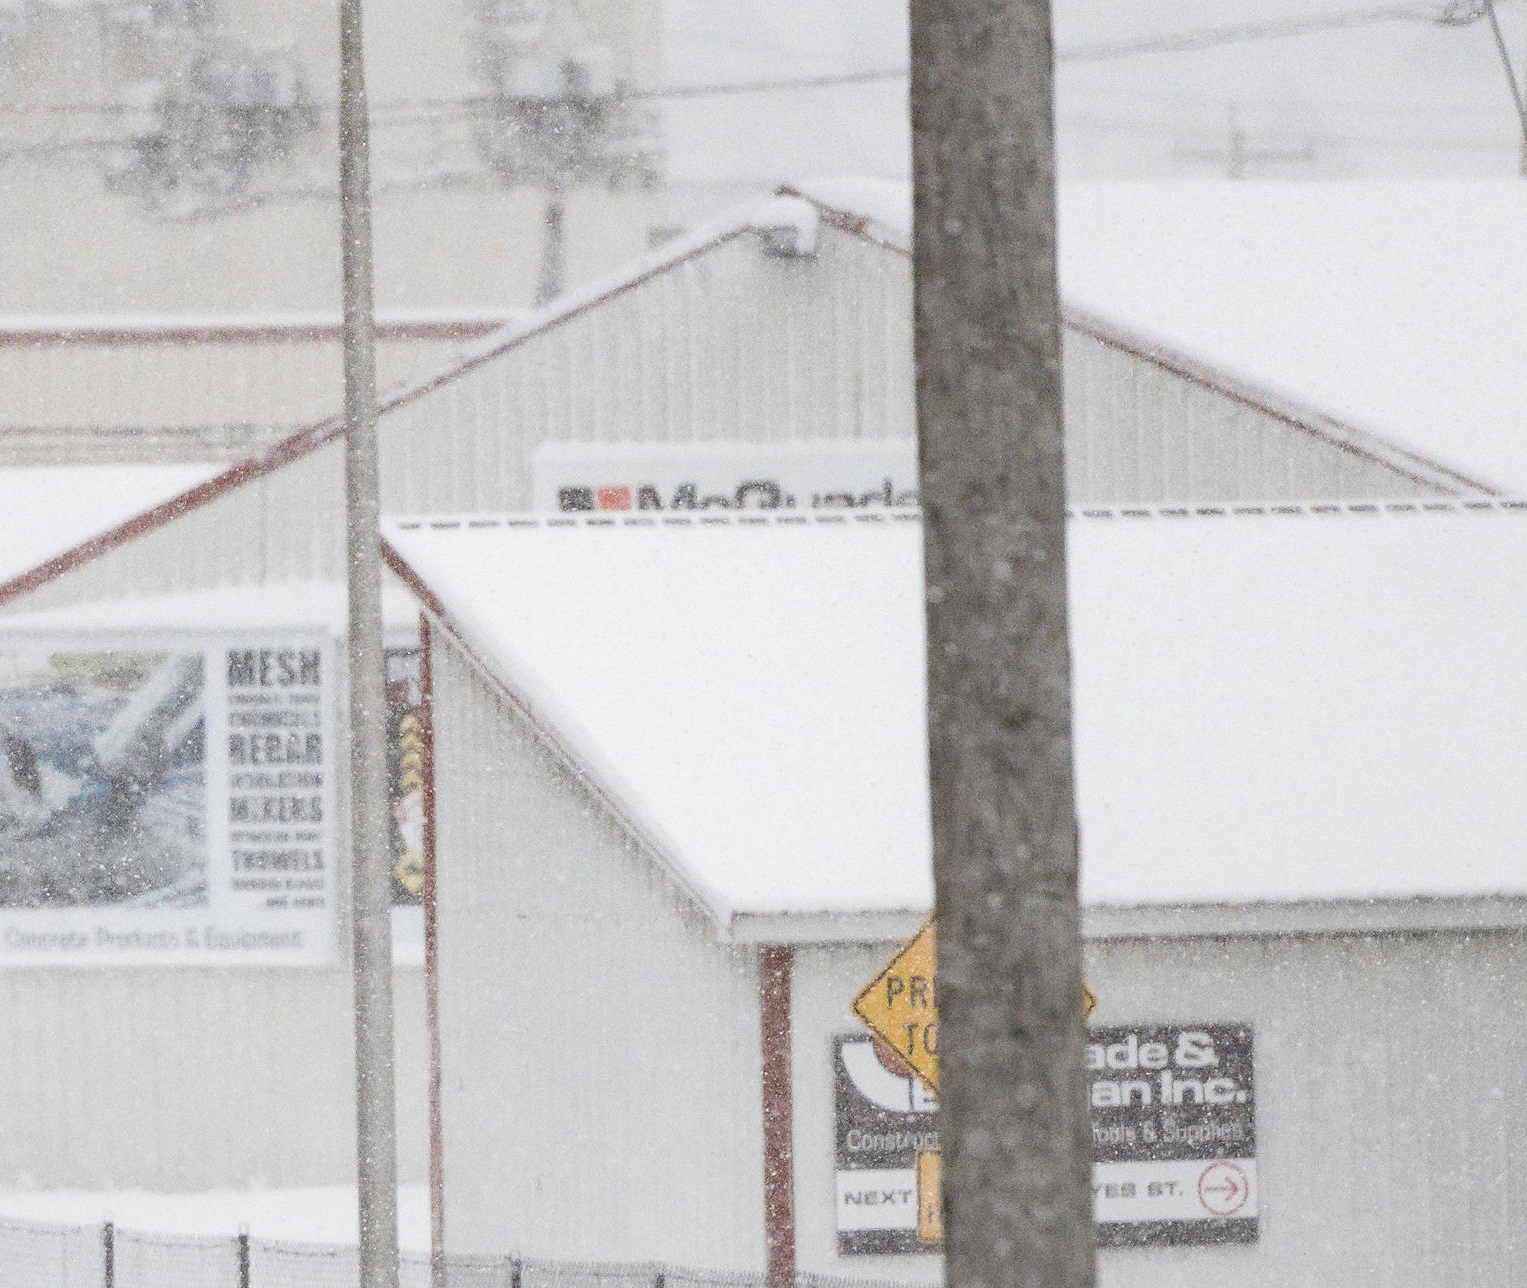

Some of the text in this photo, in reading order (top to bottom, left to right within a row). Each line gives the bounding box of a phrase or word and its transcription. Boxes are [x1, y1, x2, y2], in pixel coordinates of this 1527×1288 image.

[637, 477, 918, 510] McQuad
[227, 648, 321, 687] MESH
[1175, 1031, 1220, 1068] &
[1160, 1069, 1247, 1105] Inc.
[847, 1129, 941, 1151] Construct
[844, 1189, 913, 1206] NEXT
